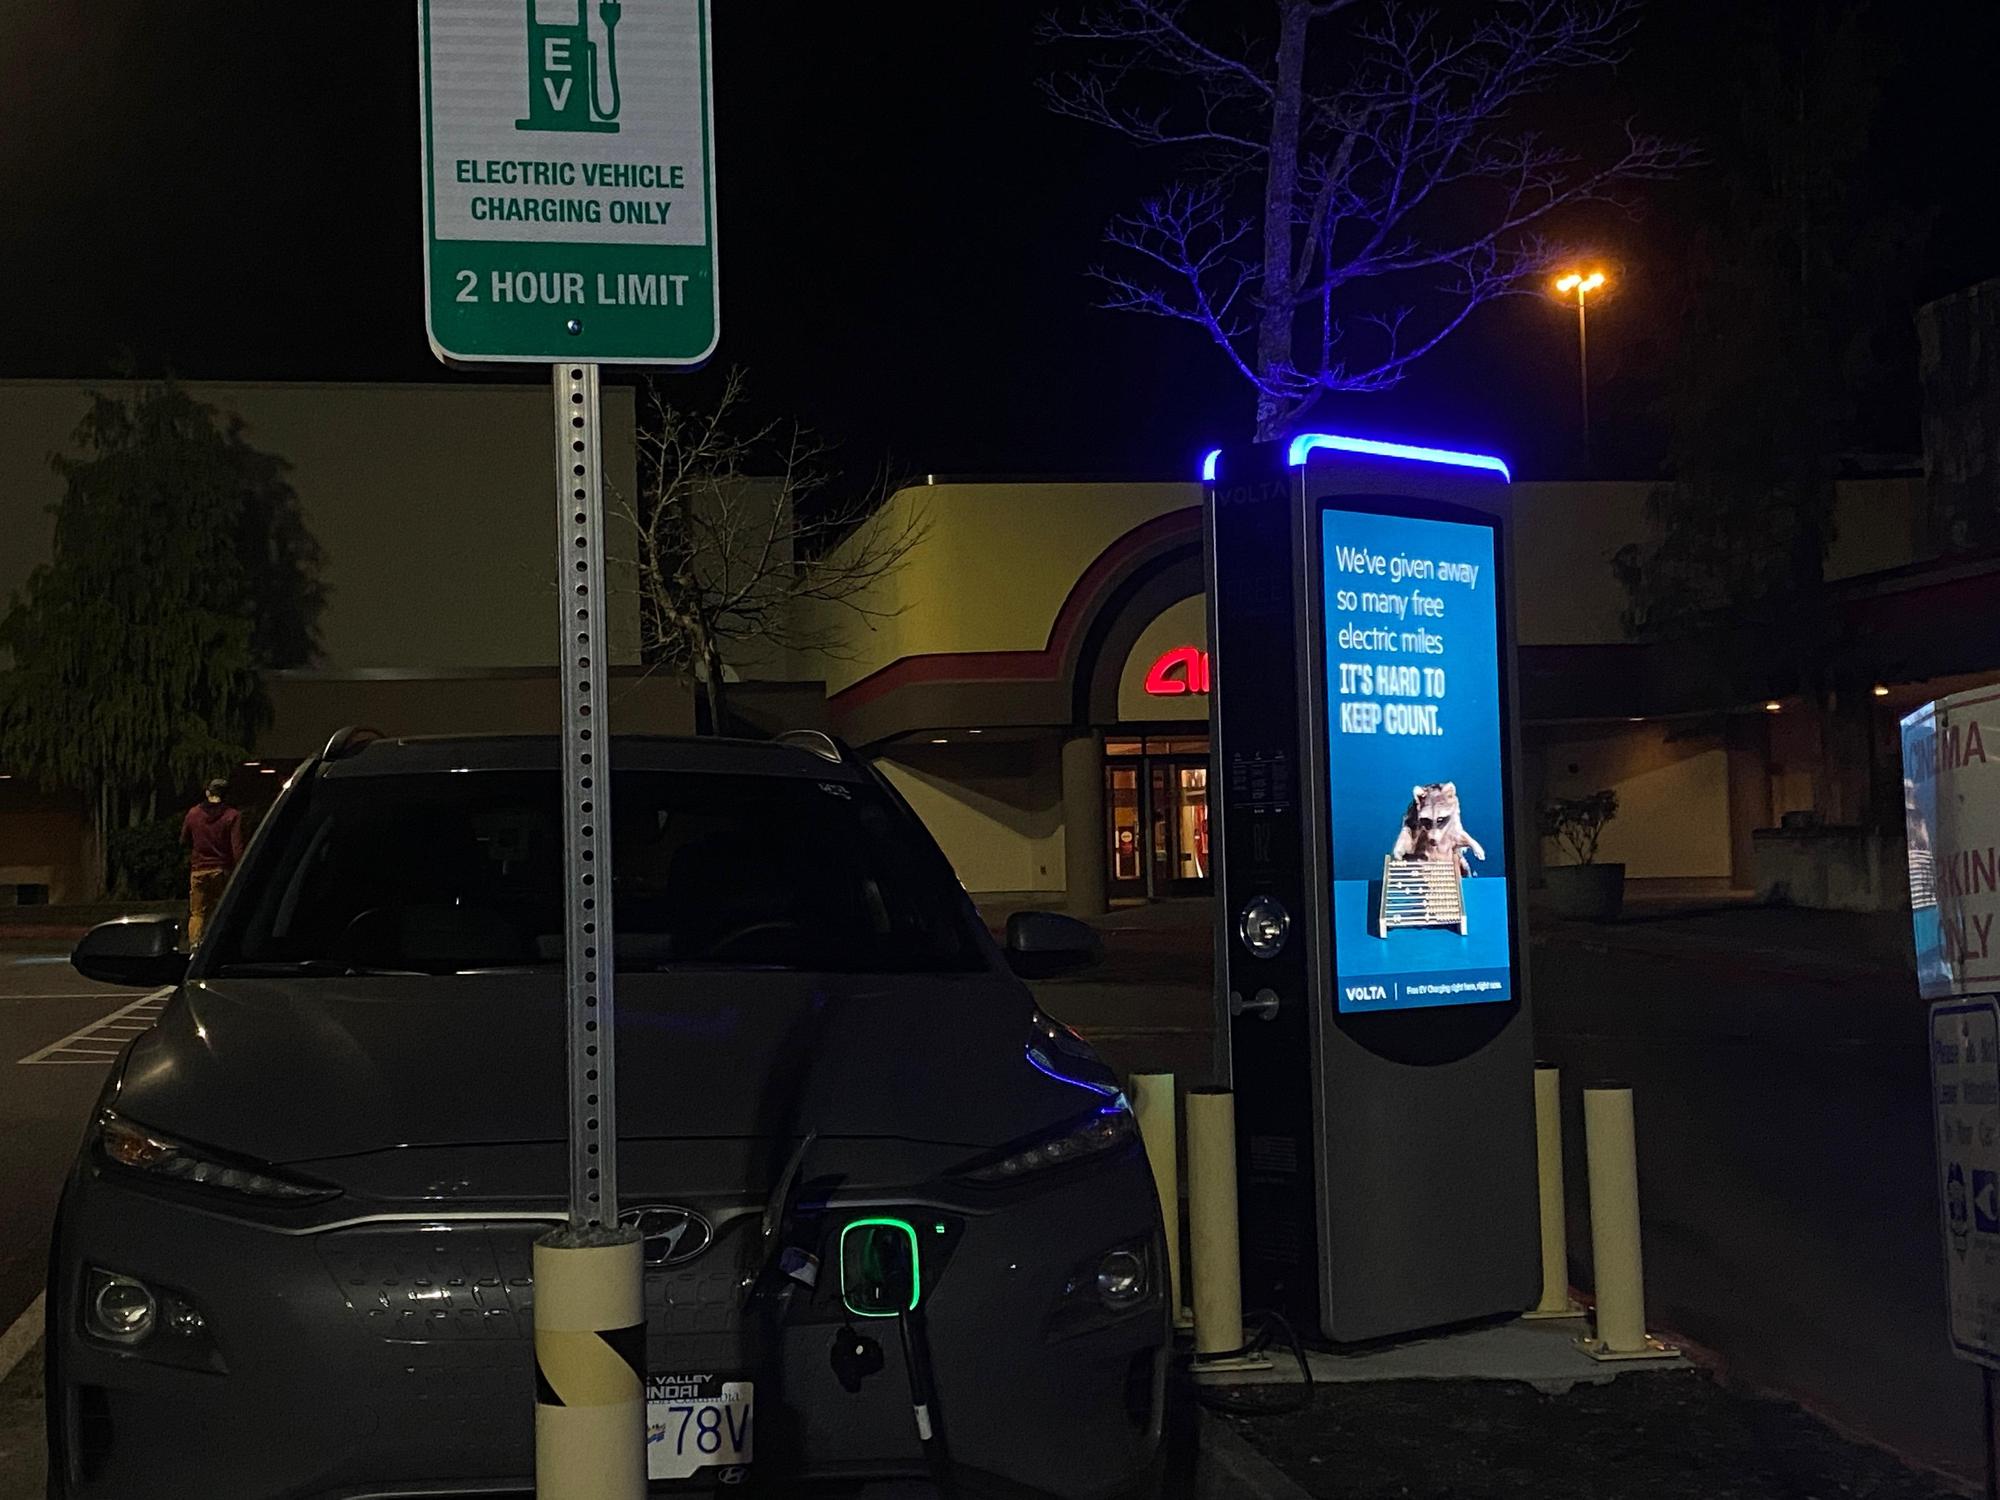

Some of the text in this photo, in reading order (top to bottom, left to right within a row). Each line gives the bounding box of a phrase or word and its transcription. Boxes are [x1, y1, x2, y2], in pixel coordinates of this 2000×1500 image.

[456, 160, 685, 189] ELECTRIC VEHICLE
[471, 197, 671, 225] CHARGING ONLY
[456, 270, 689, 306] 2 HOUR LIMIT
[1336, 545, 1479, 590] We've given away
[1336, 589, 1445, 620] so many free
[1338, 622, 1444, 655] electric miles
[1339, 663, 1445, 699] IT'S HARD TO
[1340, 702, 1444, 736] KEEP COUNT.
[1345, 985, 1387, 1001] VOLTA
[656, 1373, 713, 1385] VALLEY
[669, 1404, 749, 1455] 78V
